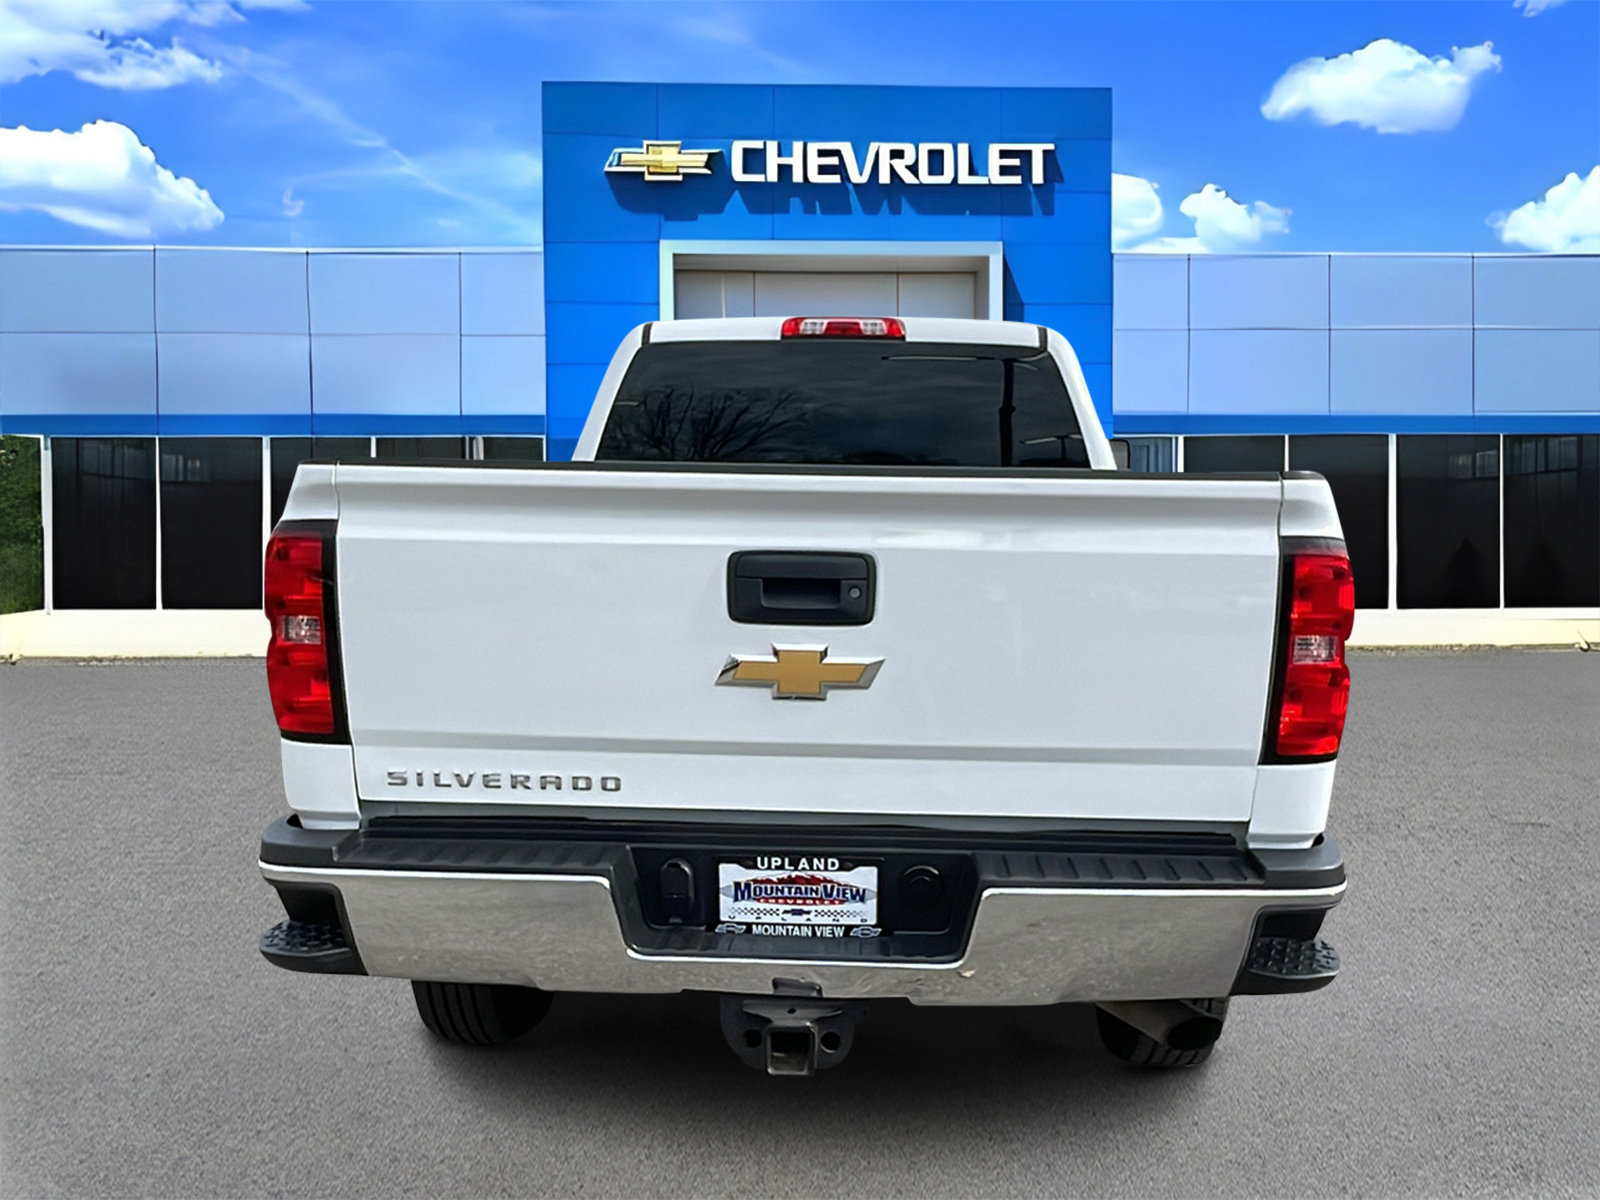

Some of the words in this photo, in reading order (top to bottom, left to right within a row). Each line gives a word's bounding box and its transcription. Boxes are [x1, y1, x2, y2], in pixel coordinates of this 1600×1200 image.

[731, 140, 1056, 184] CHEVROLET
[387, 771, 622, 792] SILVERADO
[756, 856, 840, 871] UPLAND
[752, 924, 813, 937] MOUNTAIN
[815, 926, 845, 938] VIEW
